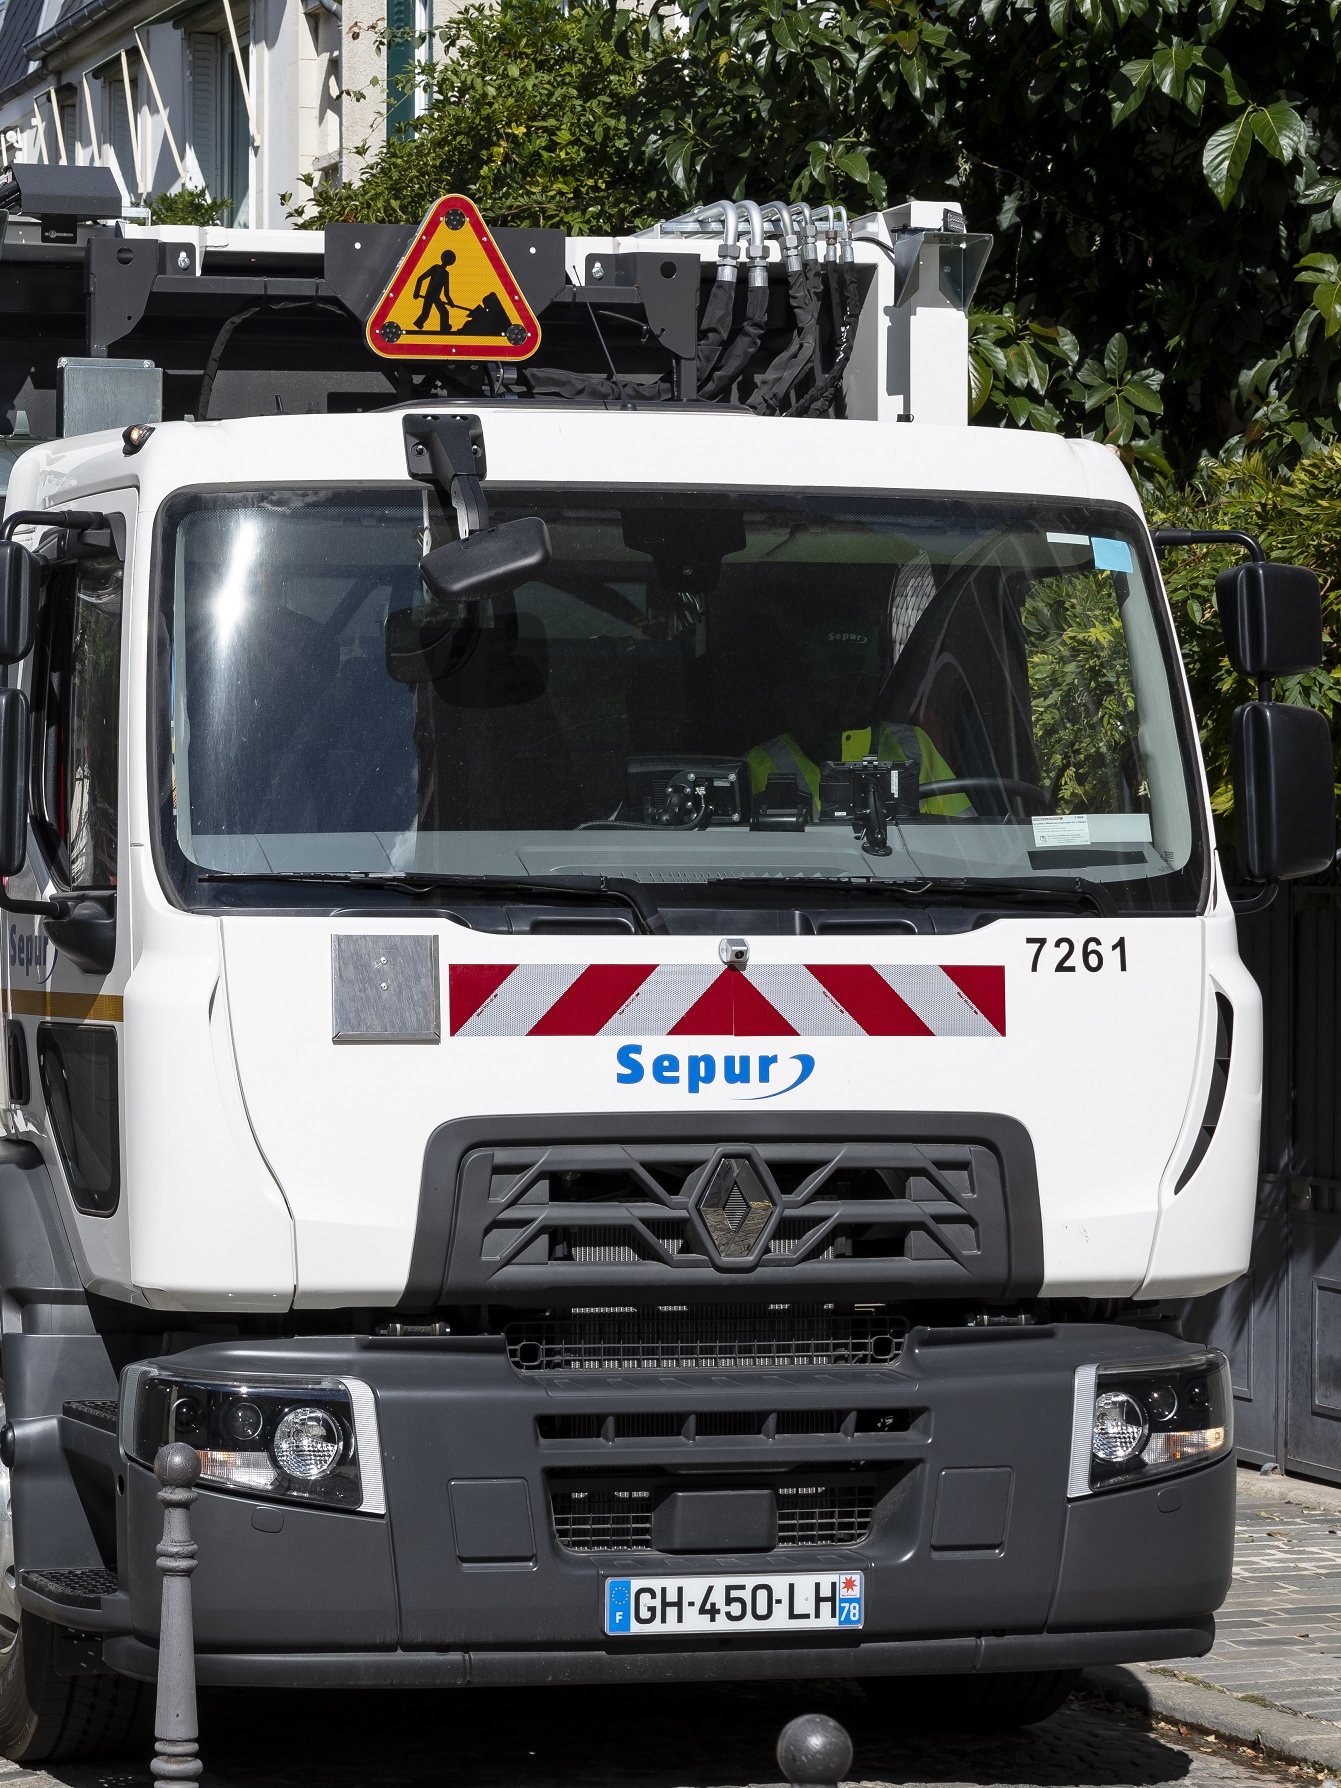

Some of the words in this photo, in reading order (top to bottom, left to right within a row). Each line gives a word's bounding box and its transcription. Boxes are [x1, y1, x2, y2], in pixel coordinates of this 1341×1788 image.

[9, 923, 49, 977] Sepur
[1025, 937, 1131, 973] 7261
[616, 1043, 779, 1094] Sepur
[615, 1611, 624, 1624] F
[633, 1581, 838, 1625] GH-450-LH
[840, 1602, 859, 1621] 78
